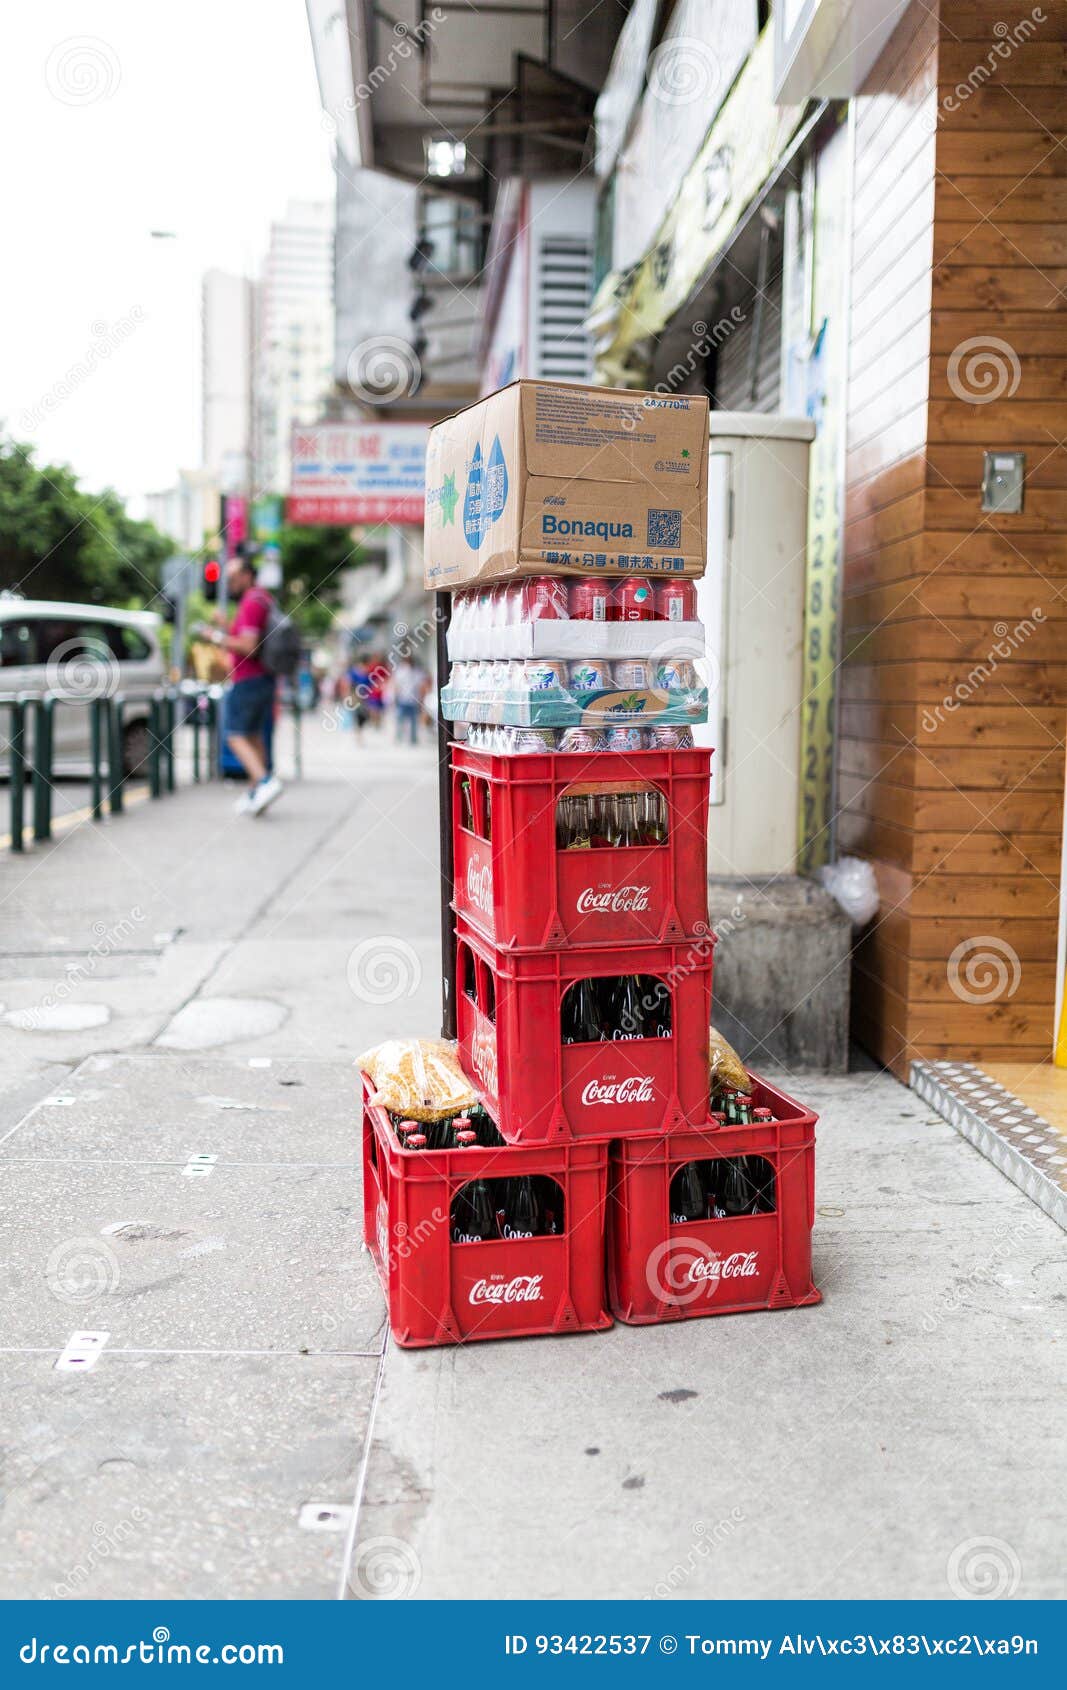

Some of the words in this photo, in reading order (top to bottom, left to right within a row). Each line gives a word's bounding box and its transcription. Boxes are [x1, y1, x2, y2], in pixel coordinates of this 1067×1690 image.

[543, 515, 633, 541] Bonaqua
[576, 885, 652, 914] Coca-Cola
[581, 1076, 656, 1105] Coca-Cola
[503, 1223, 533, 1240] Coke
[688, 1251, 760, 1283] Coca-Cola
[468, 1275, 544, 1305] Coca-Cola
